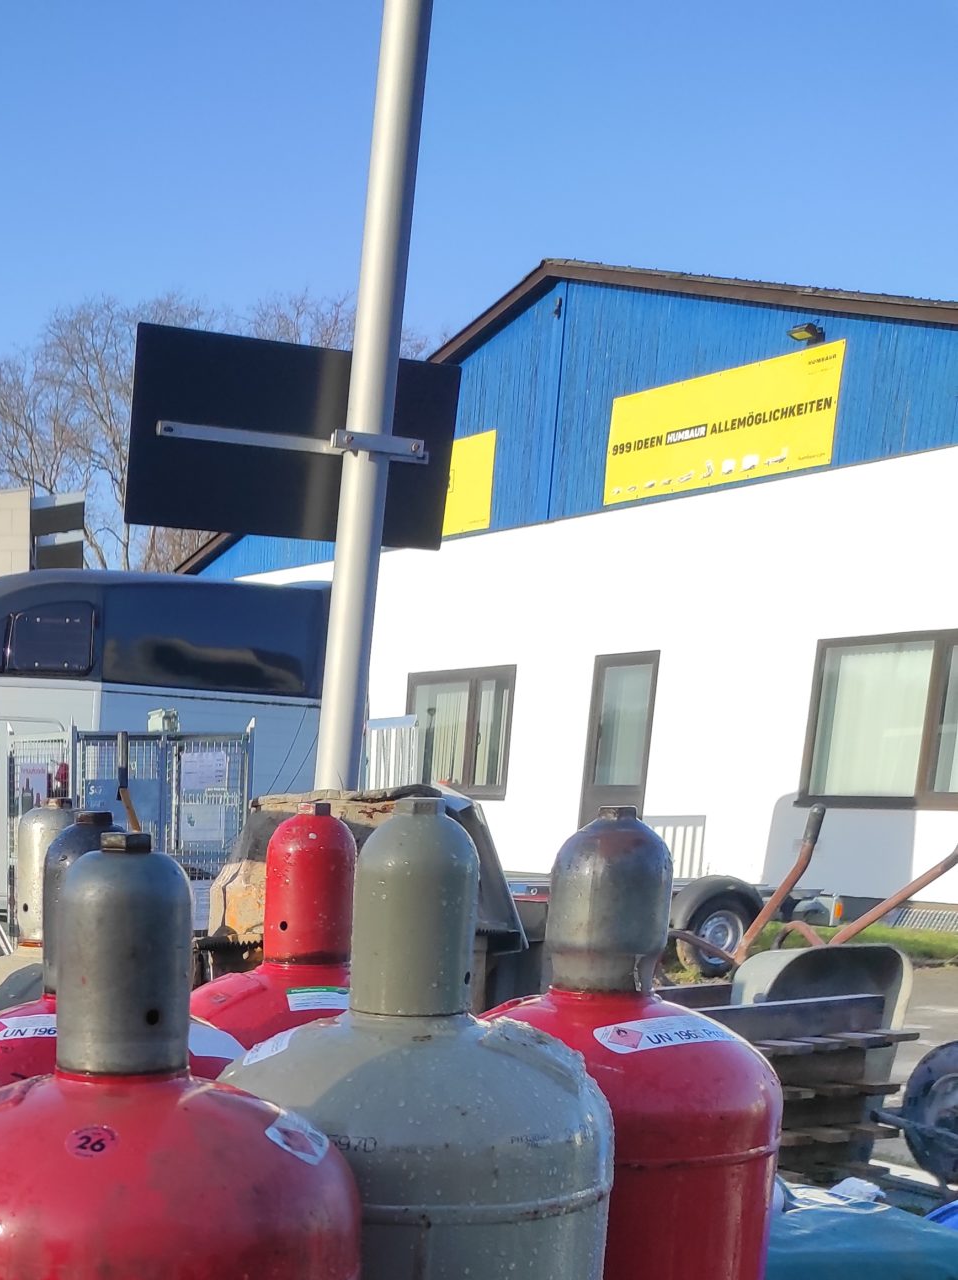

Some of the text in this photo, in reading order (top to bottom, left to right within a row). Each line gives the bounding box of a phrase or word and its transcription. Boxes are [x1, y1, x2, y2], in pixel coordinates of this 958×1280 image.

[612, 396, 833, 456] 999 IDEEN HUMBAUR ALLEMÖGLICHKEITEN
[3, 1026, 57, 1037] UN 196
[646, 1032, 674, 1045] UN
[76, 1135, 106, 1152] 26
